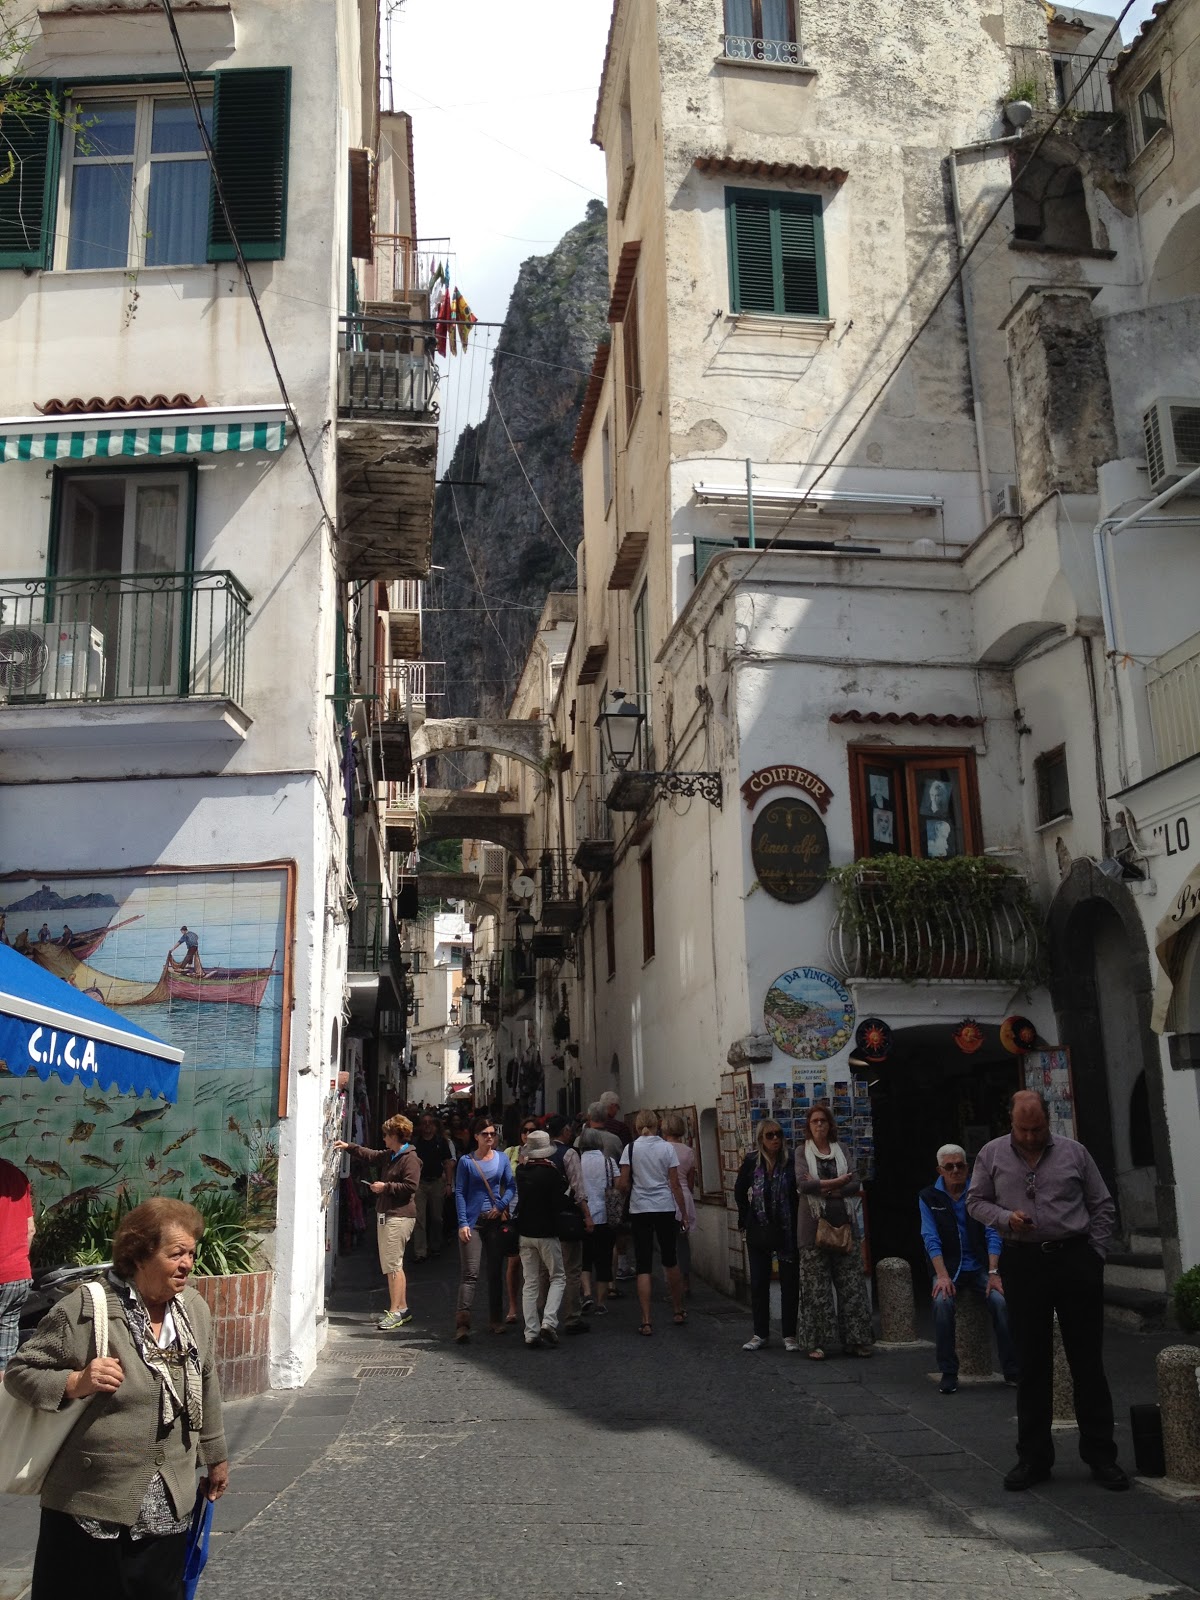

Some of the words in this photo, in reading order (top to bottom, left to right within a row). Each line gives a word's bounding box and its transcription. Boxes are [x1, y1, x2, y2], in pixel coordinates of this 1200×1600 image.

[750, 768, 825, 798] COIFFEUR
[792, 834, 821, 863] alfa
[784, 970, 801, 984] DA
[803, 968, 849, 1002] VINCENZO
